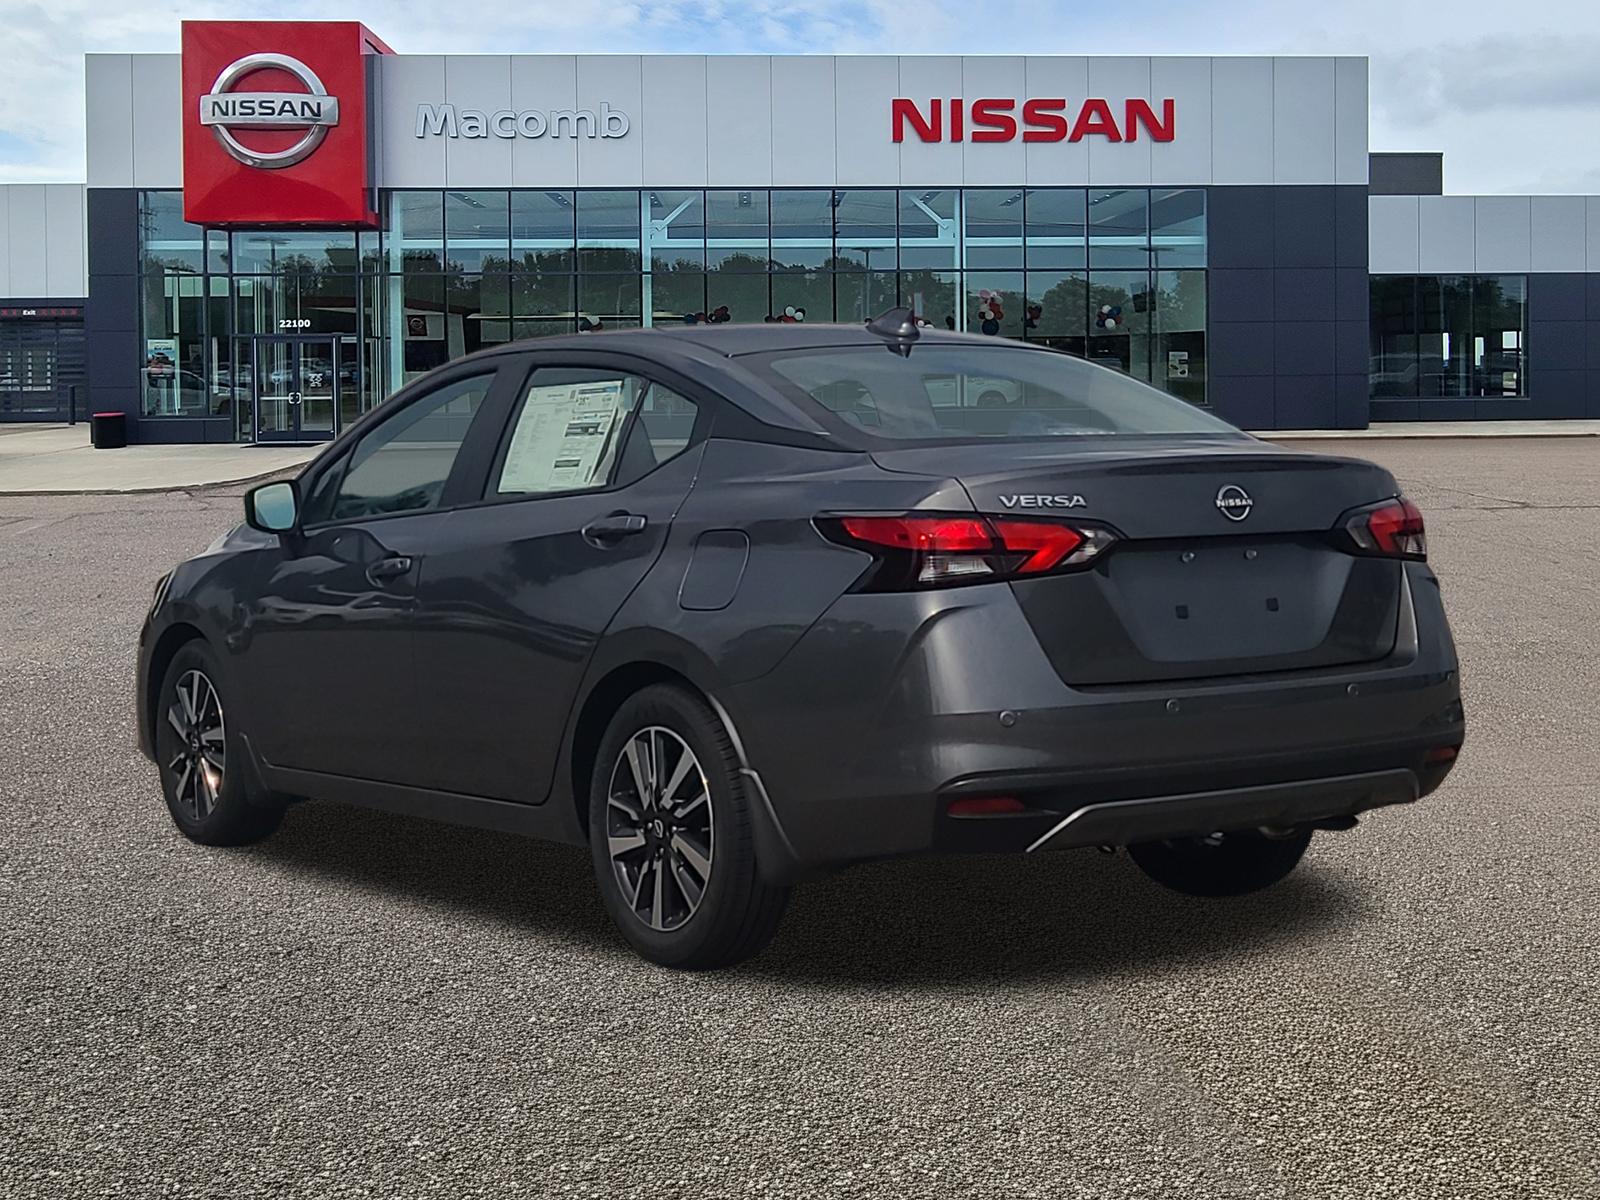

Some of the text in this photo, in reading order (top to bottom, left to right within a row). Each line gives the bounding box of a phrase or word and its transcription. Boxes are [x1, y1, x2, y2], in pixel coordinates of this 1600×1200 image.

[211, 100, 322, 118] NISSAN
[415, 103, 630, 138] Macomb
[892, 98, 1175, 142] NISSAN
[279, 319, 311, 328] 22100
[999, 495, 1087, 508] VERSA
[1216, 498, 1253, 507] NISSAN
